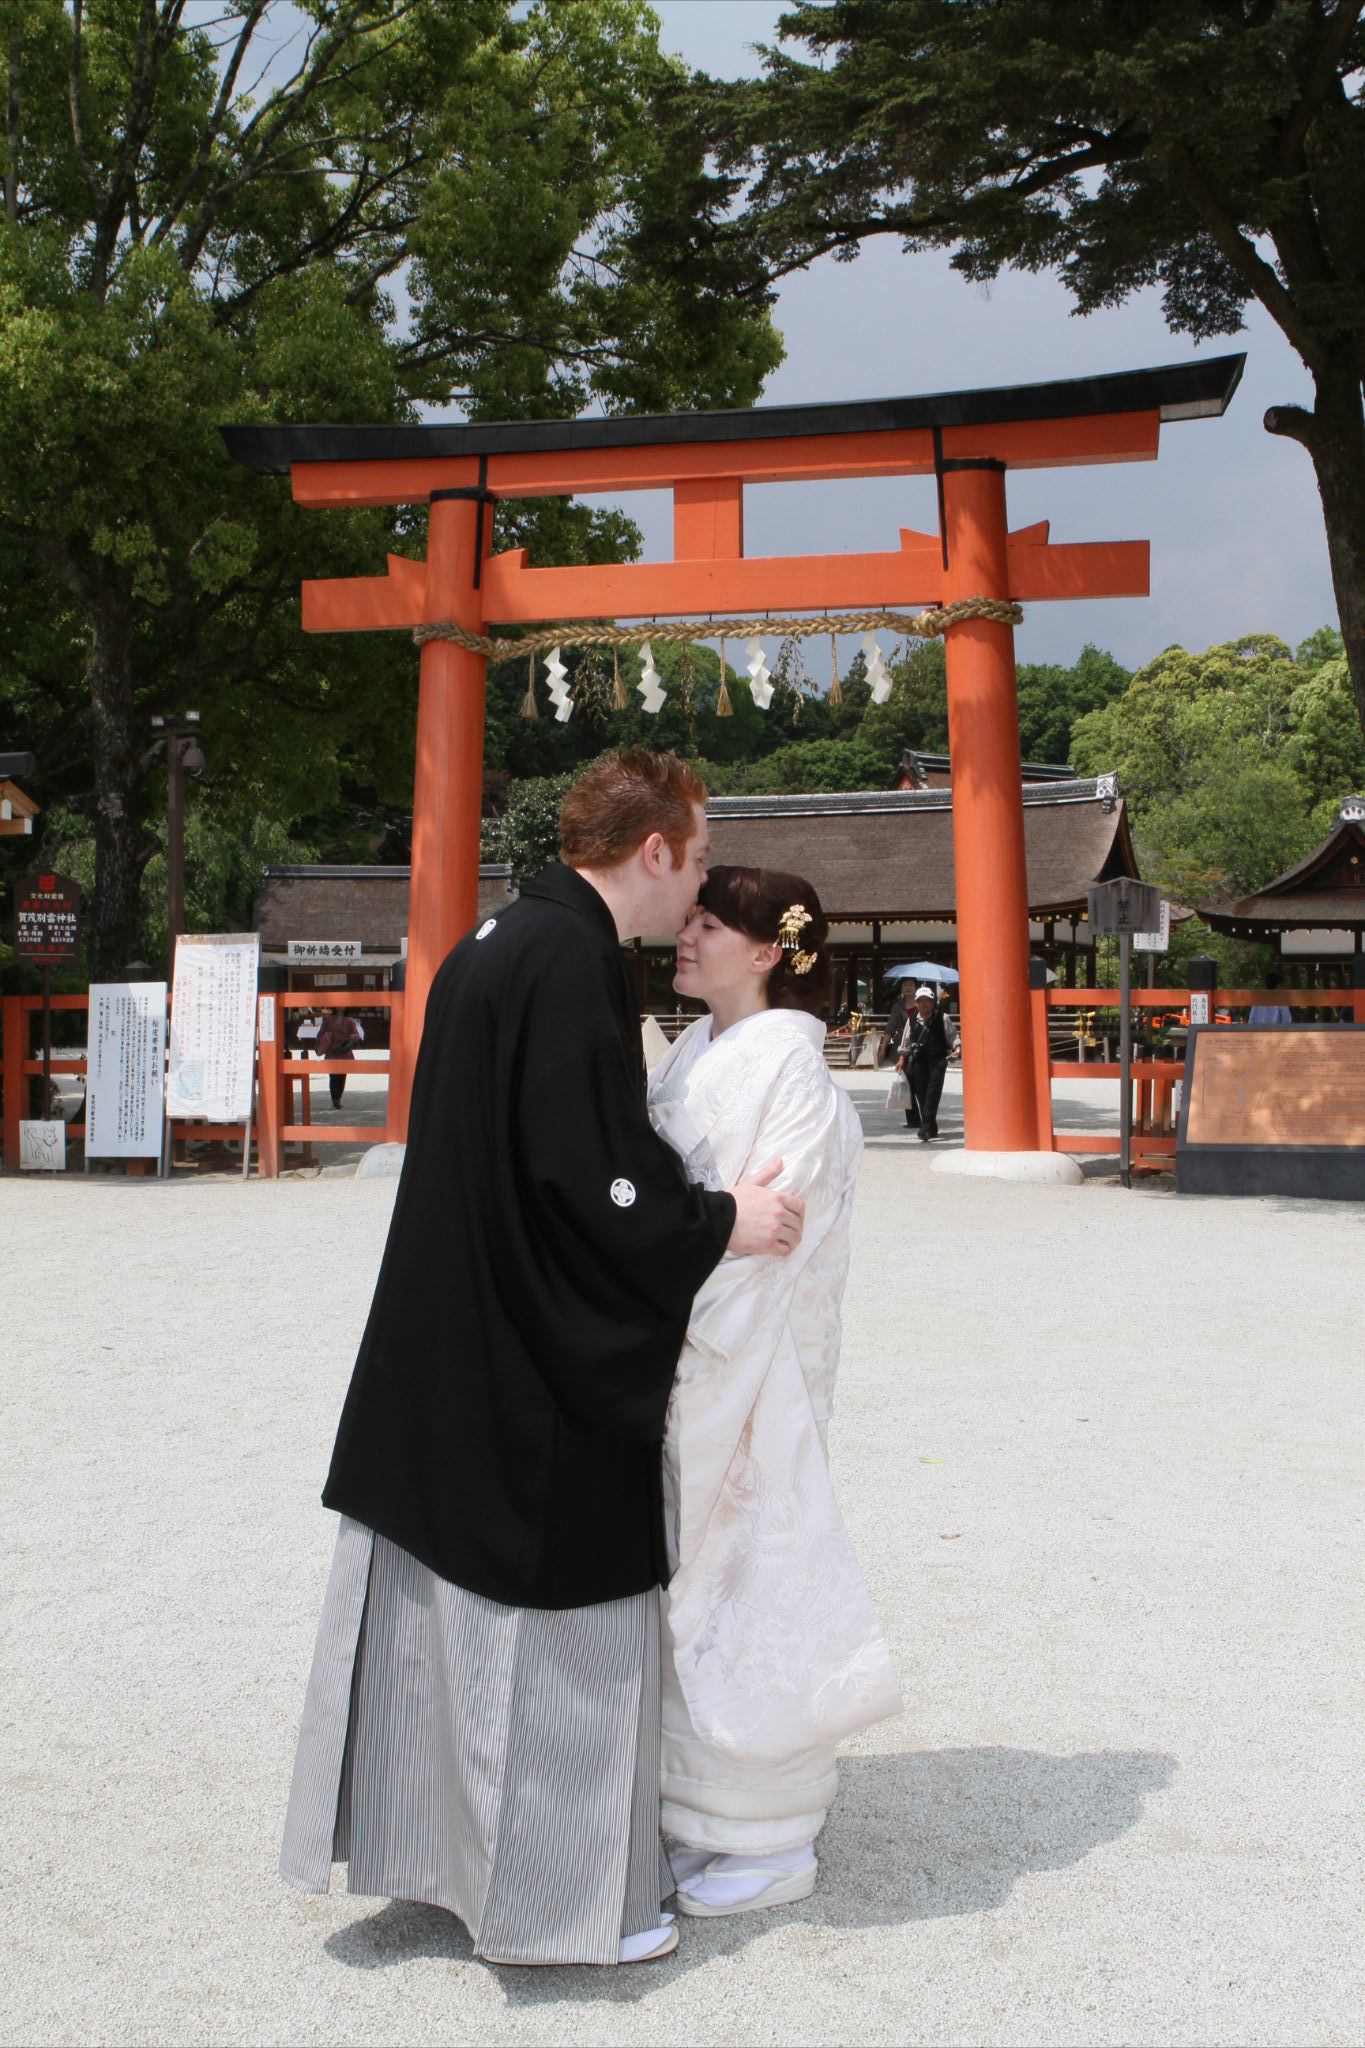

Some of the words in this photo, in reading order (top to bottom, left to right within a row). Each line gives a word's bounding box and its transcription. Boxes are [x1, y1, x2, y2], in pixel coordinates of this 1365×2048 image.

[18, 912, 77, 923] 賀茂別雷神社
